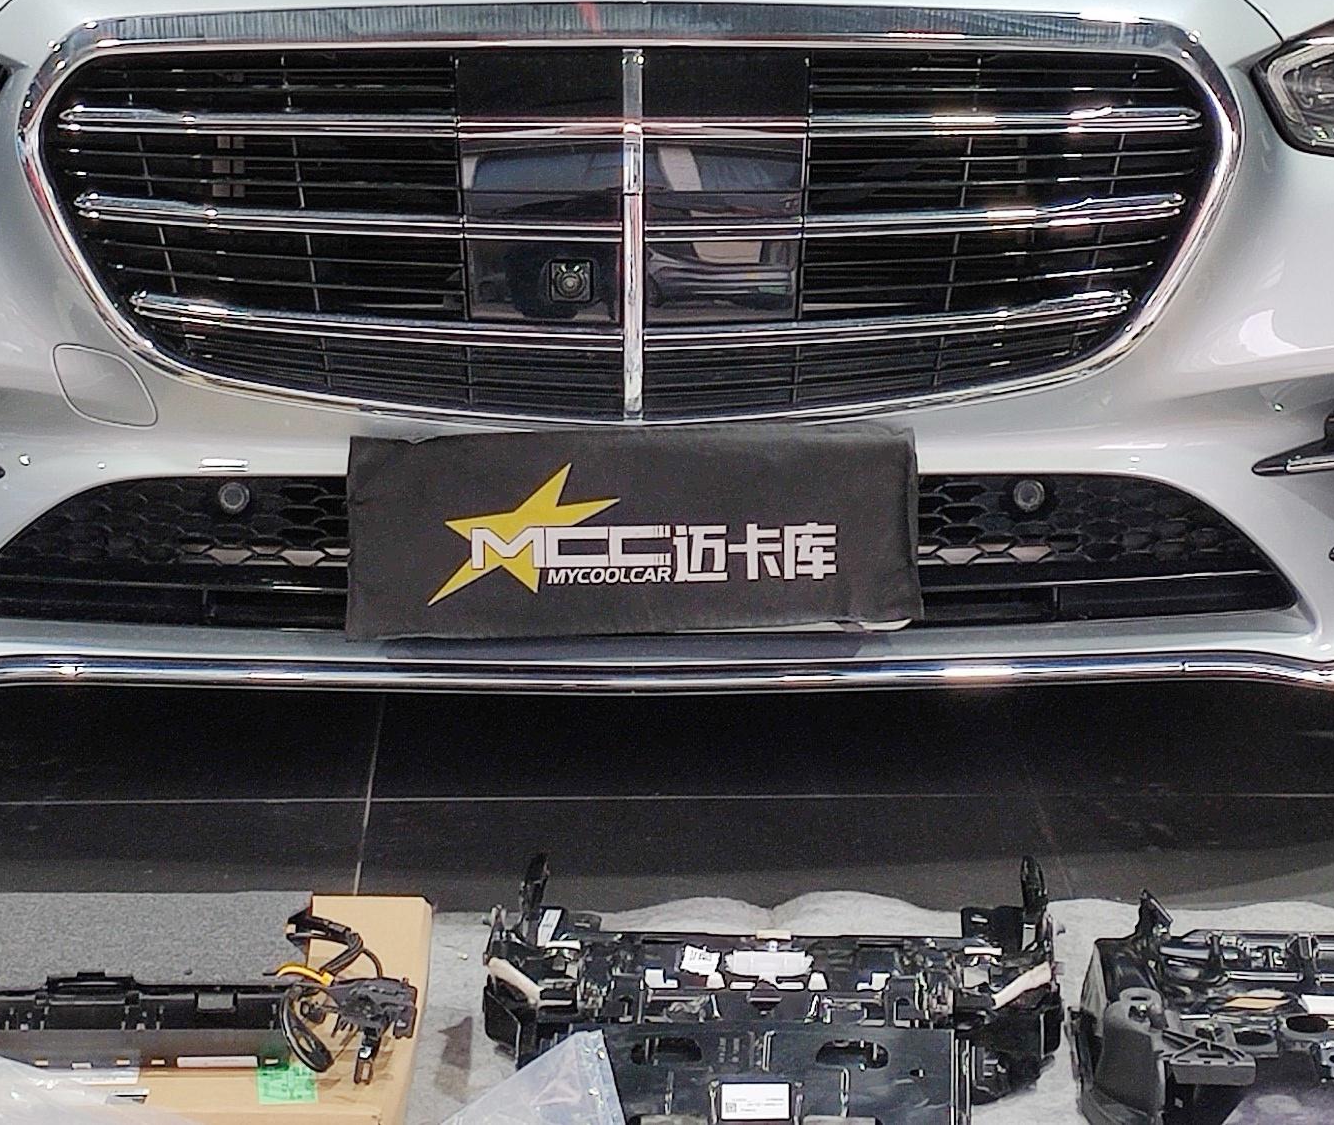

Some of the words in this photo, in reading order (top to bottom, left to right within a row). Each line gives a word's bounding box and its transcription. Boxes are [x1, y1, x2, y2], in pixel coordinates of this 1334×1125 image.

[471, 525, 671, 569] MCC
[673, 522, 837, 582] 迈卡库
[547, 567, 671, 584] MYCOOLCAR
